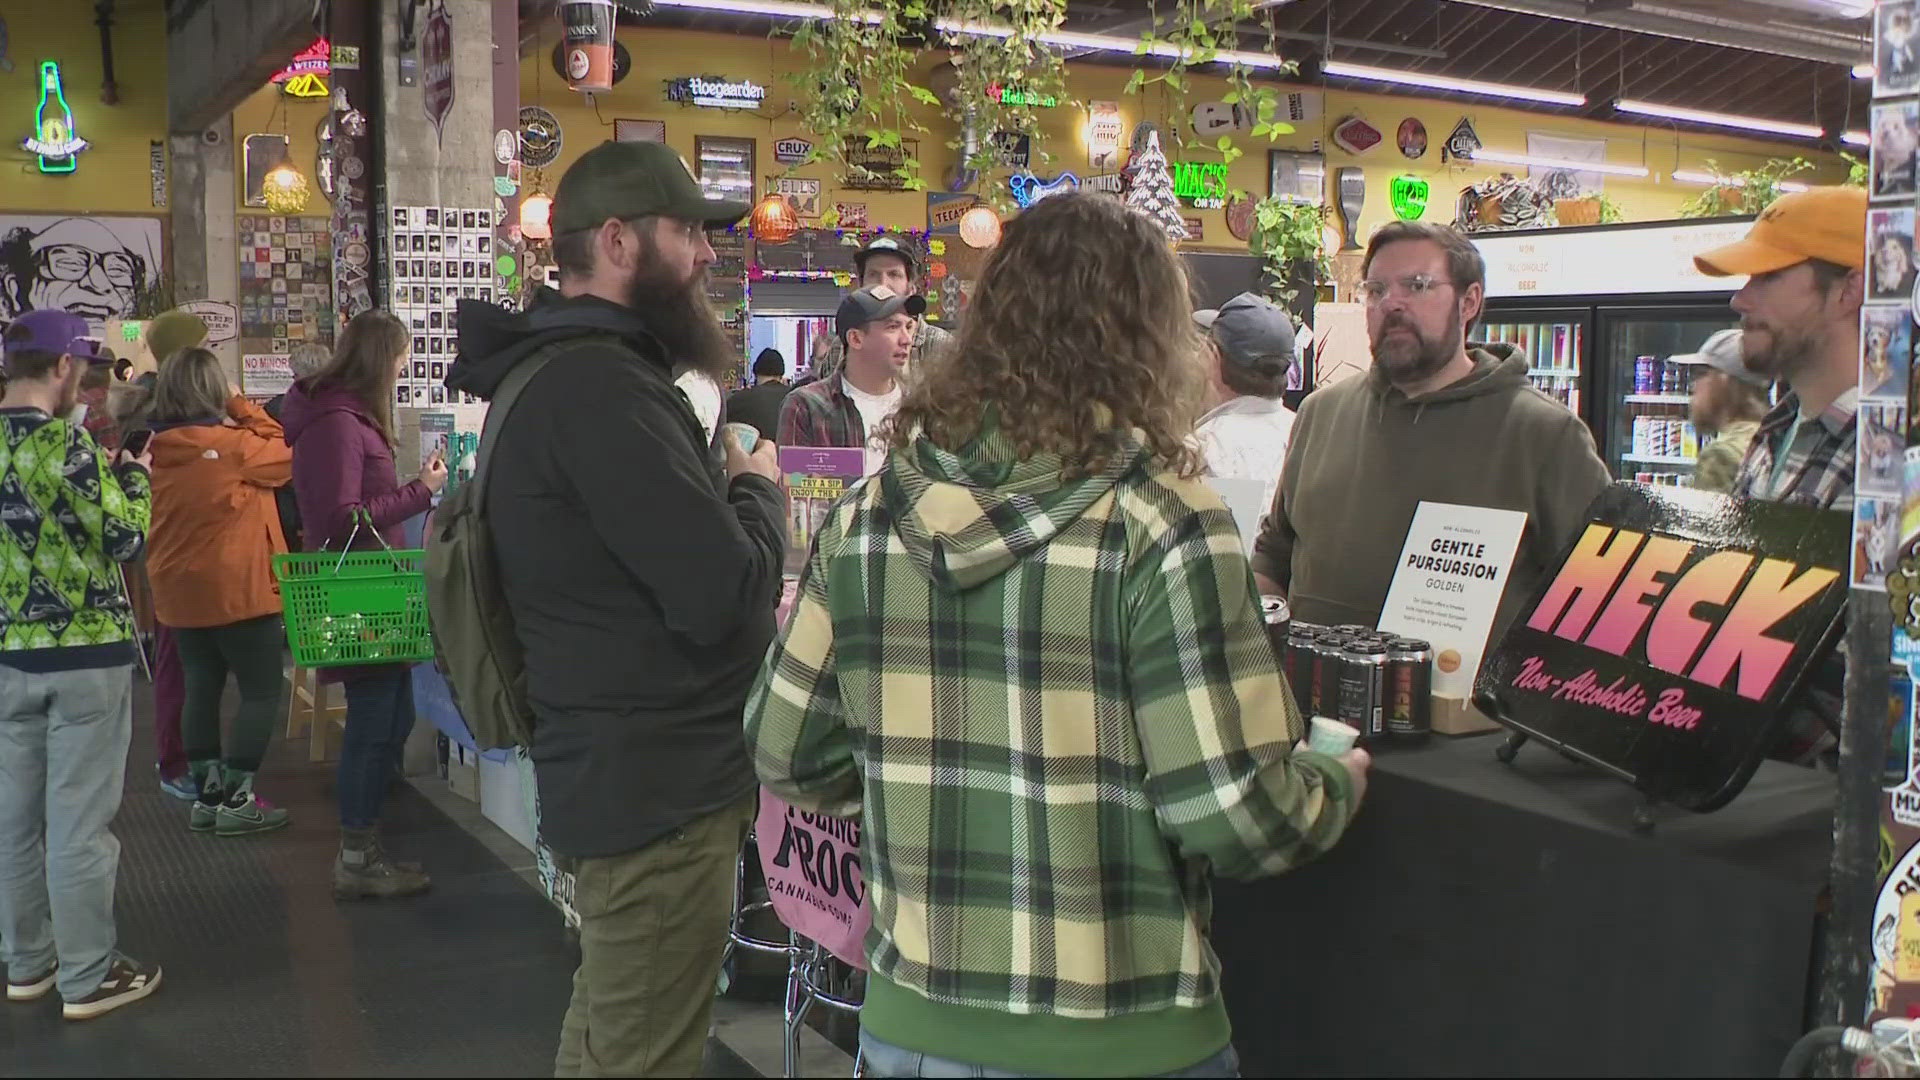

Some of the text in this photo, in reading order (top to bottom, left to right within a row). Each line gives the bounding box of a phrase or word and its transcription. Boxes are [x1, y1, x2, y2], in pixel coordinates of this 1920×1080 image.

[690, 78, 764, 98] Hoegaarden
[778, 142, 810, 154] CRUX
[1518, 281, 1537, 290] BEER
[245, 357, 290, 368] NO MINOR
[802, 479, 817, 487] TRY
[790, 488, 815, 497] ENJOY
[818, 489, 833, 498] THE
[1431, 538, 1485, 558] GENTLE
[1407, 554, 1498, 581] PURSUASION
[1425, 578, 1465, 593] GOLDEN
[1526, 523, 1841, 702] HECK
[1512, 656, 1702, 730] Non-Alcoholic Beer
